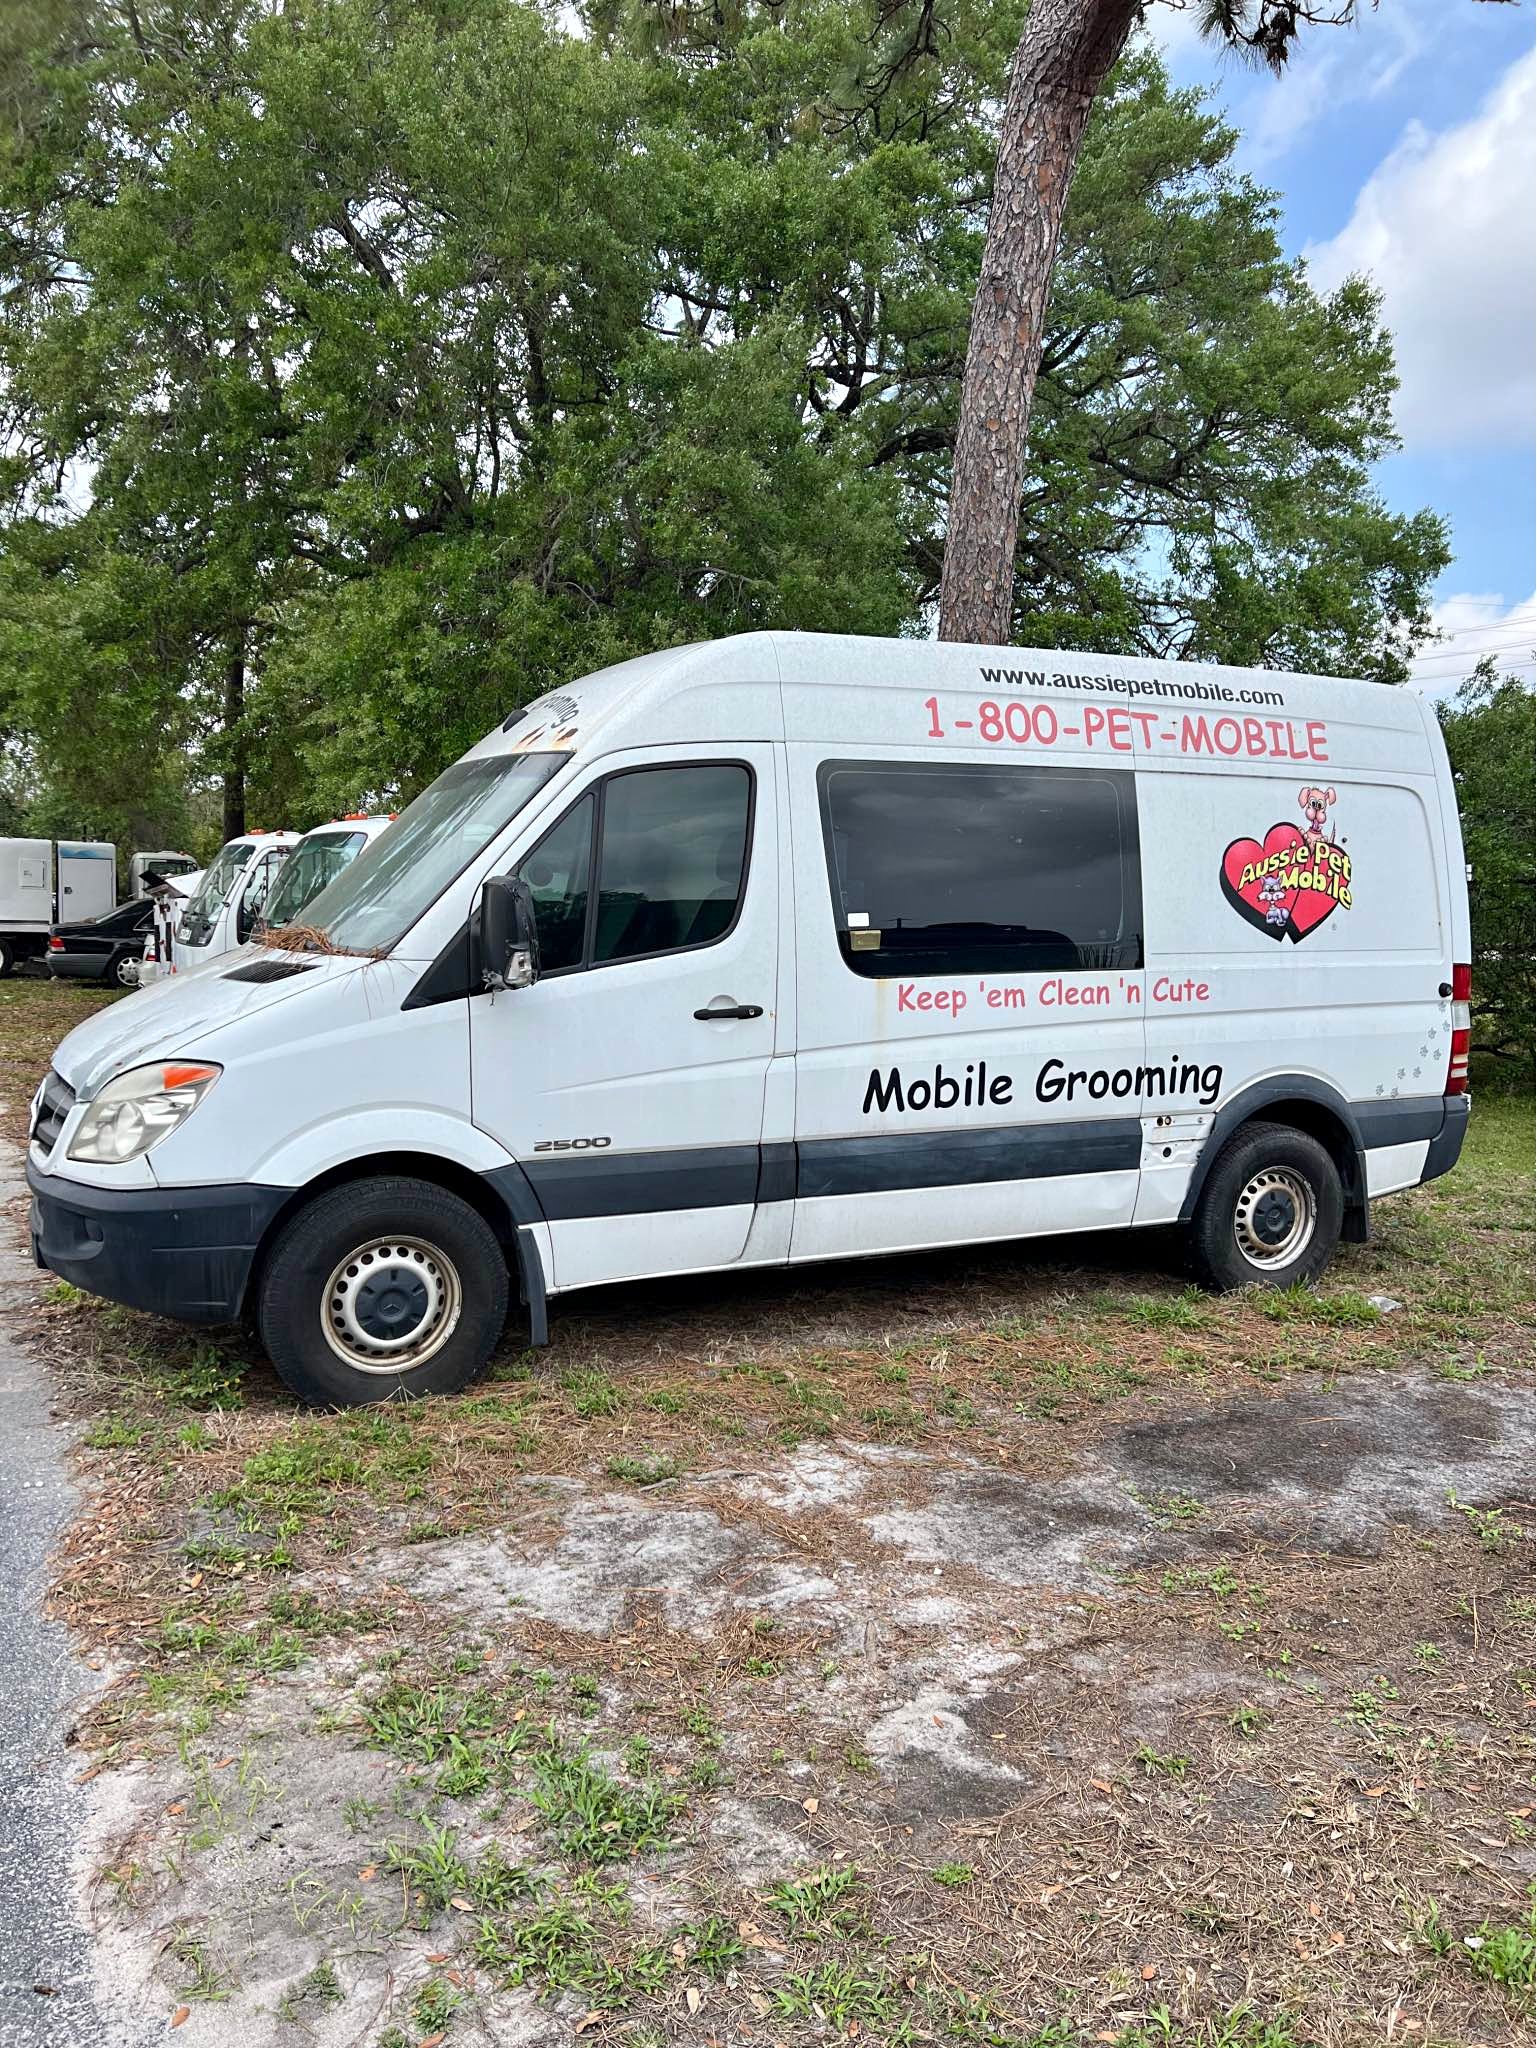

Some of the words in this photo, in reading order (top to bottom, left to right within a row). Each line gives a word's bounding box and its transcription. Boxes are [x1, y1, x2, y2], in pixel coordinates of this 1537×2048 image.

[980, 667, 1285, 706] www.aussiepetmobile.com
[925, 696, 1329, 761] 1-800-PET-MOBILE
[1237, 840, 1309, 891] Aussie
[1315, 840, 1352, 882] Pet
[1280, 866, 1353, 910] Mobile
[898, 984, 967, 1018] Keep
[979, 981, 1026, 1009] 'em
[1039, 979, 1111, 1006] Clean
[1119, 976, 1141, 1004] 'n
[1152, 976, 1210, 1002] Cute
[862, 1061, 1013, 1114] Mobile
[1035, 1054, 1223, 1105] Grooming
[533, 1136, 612, 1152] 2500
